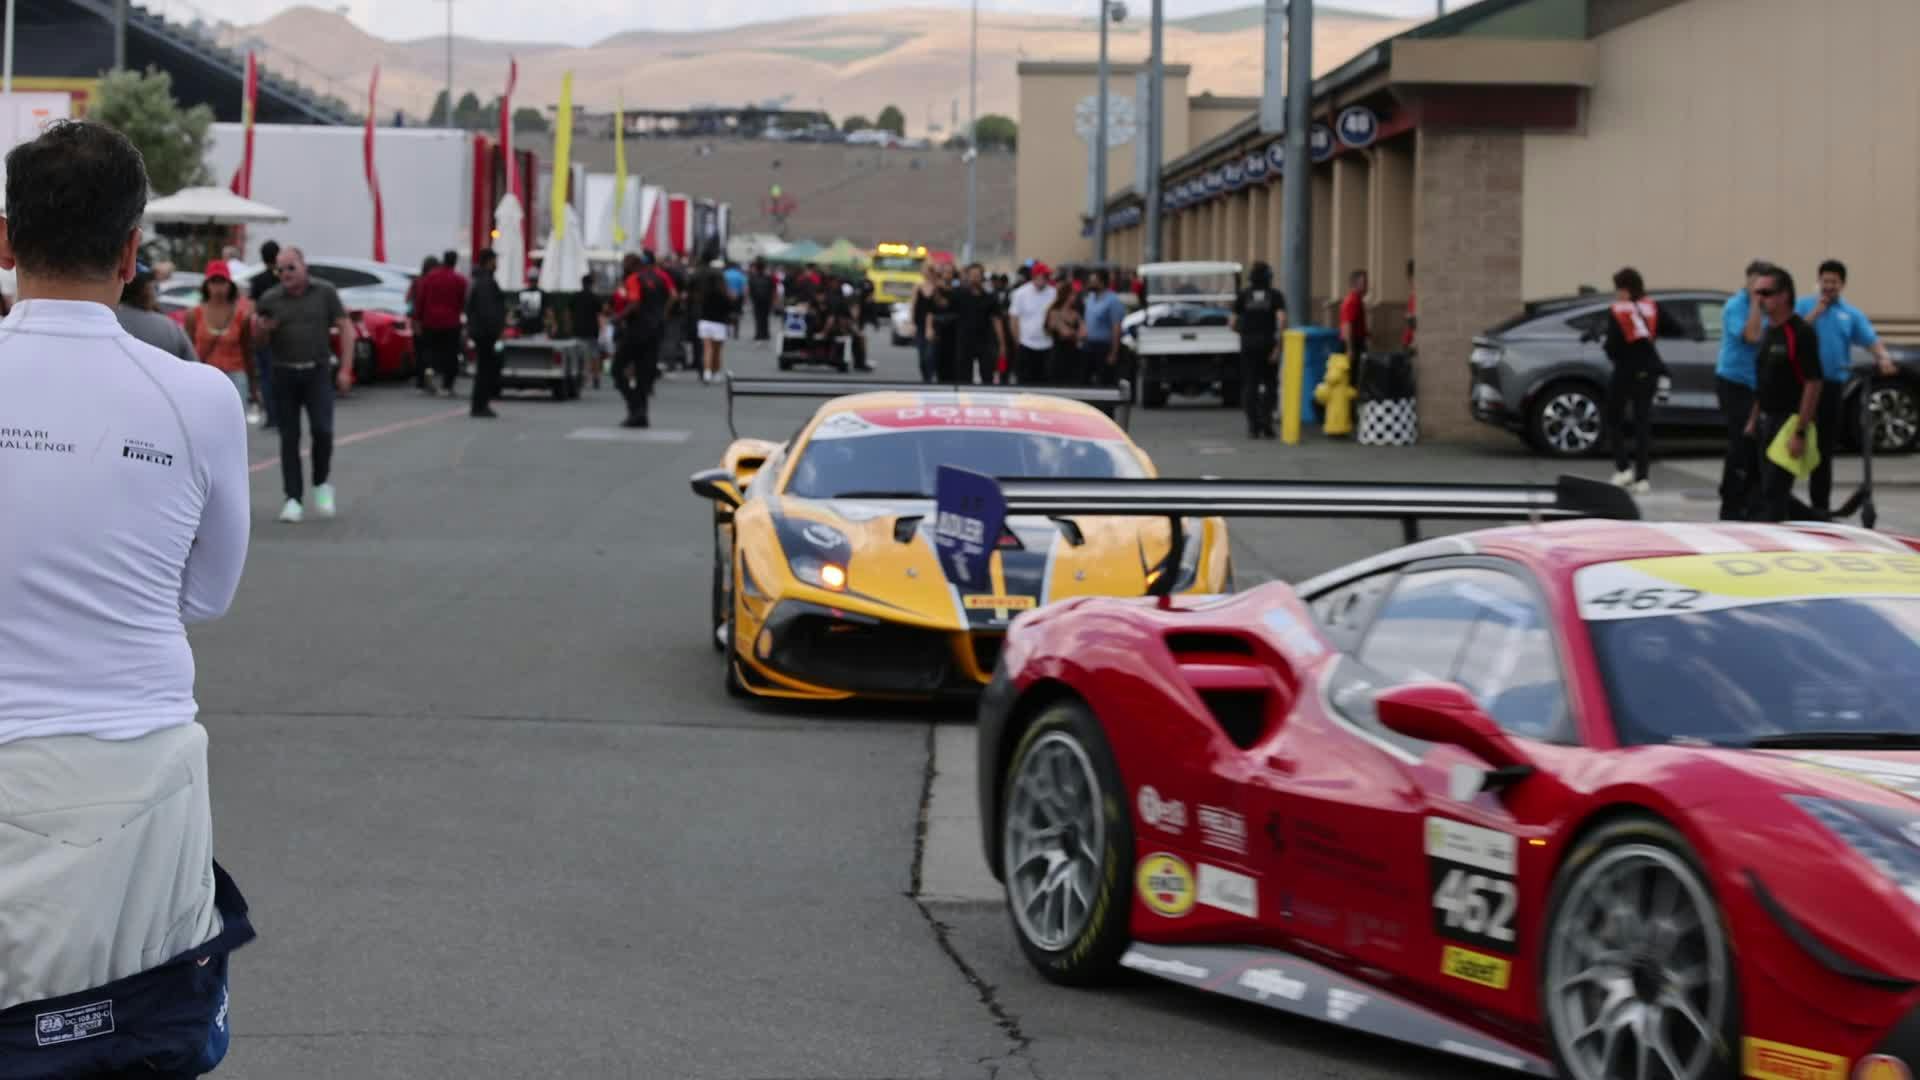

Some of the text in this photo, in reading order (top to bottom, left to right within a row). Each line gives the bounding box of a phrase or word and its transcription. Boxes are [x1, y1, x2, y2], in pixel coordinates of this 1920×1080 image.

[896, 406, 1054, 424] DOBEL
[123, 446, 173, 467] PIRELLI
[1590, 588, 1702, 611] 462
[1432, 868, 1519, 943] 462
[40, 1016, 63, 1032] FIA
